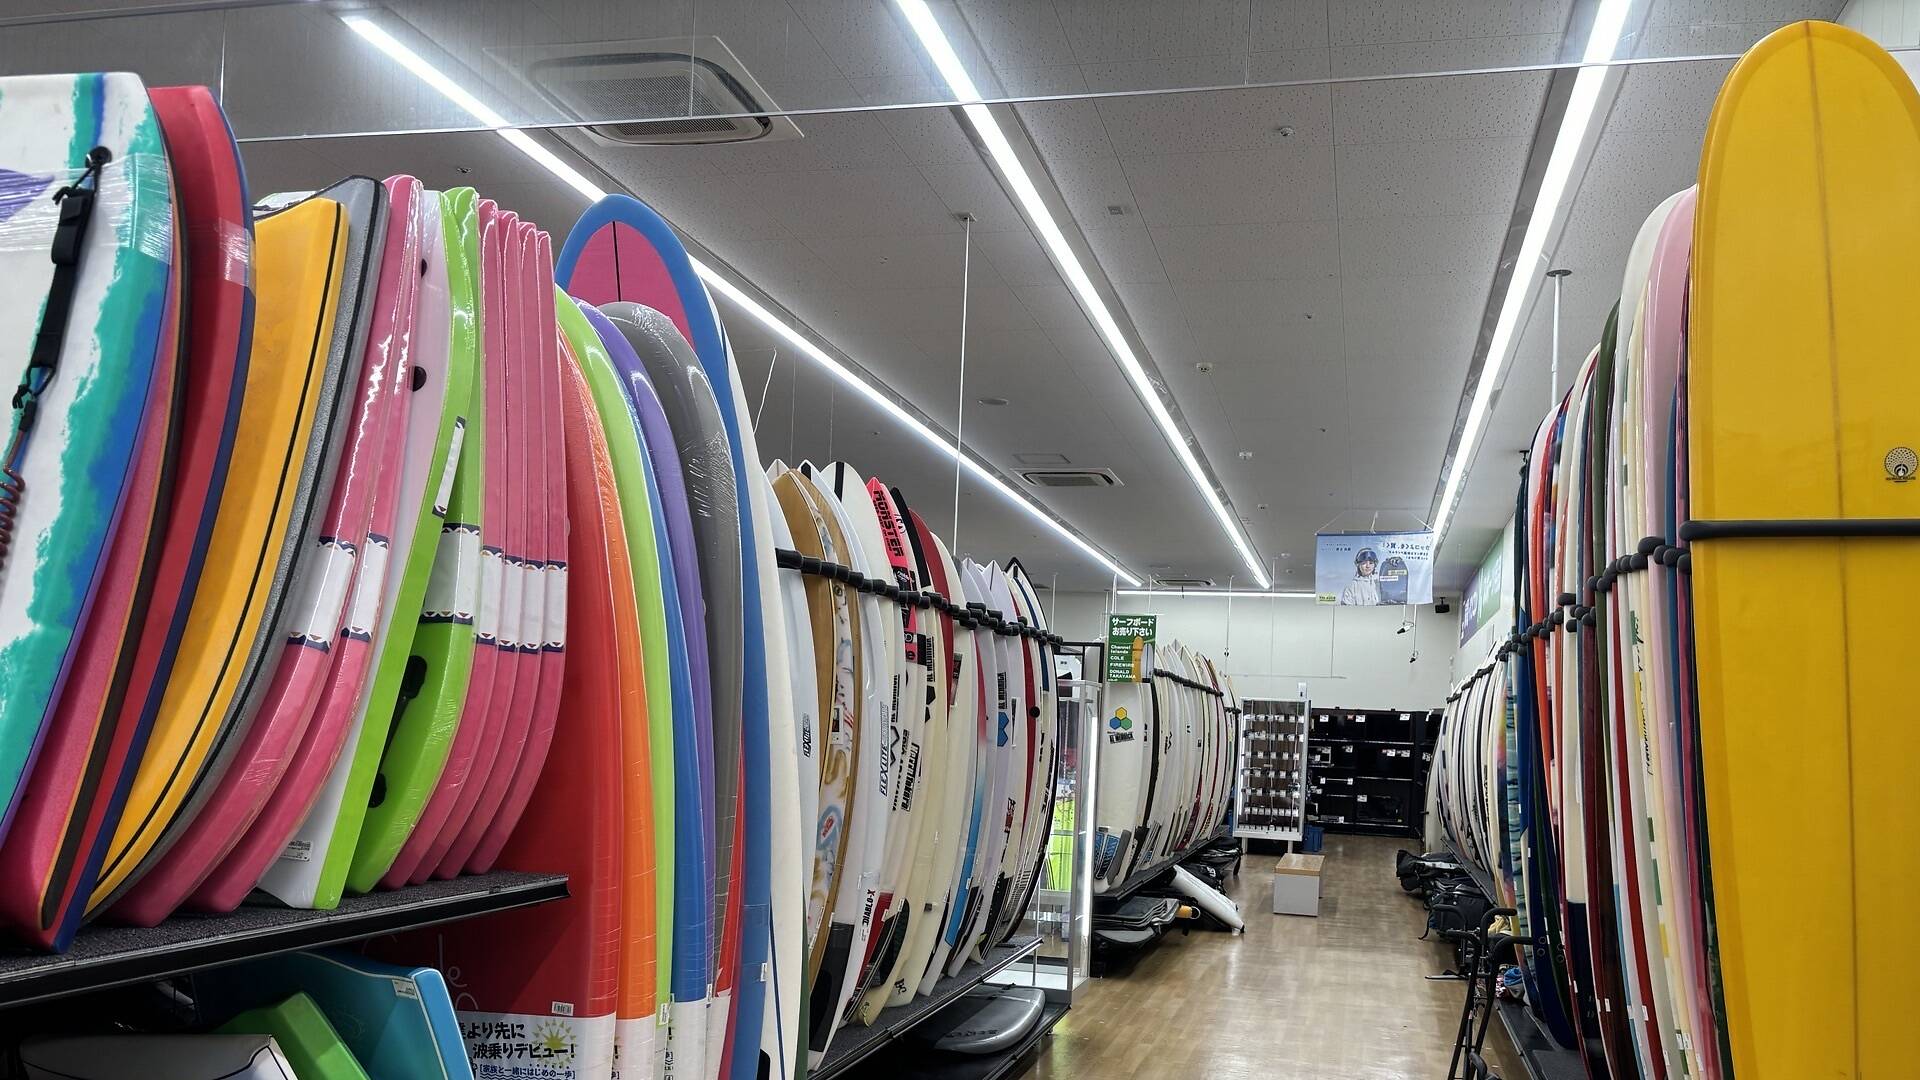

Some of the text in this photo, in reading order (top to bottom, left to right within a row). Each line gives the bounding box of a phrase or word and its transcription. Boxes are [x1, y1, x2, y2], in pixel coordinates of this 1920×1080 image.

[873, 490, 904, 557] MONSTER
[1111, 617, 1154, 626] サーフボード
[1112, 627, 1153, 636] お売り下さい
[862, 889, 876, 926] DIABLO-X
[473, 1043, 575, 1060] 波乗りデビュー!
